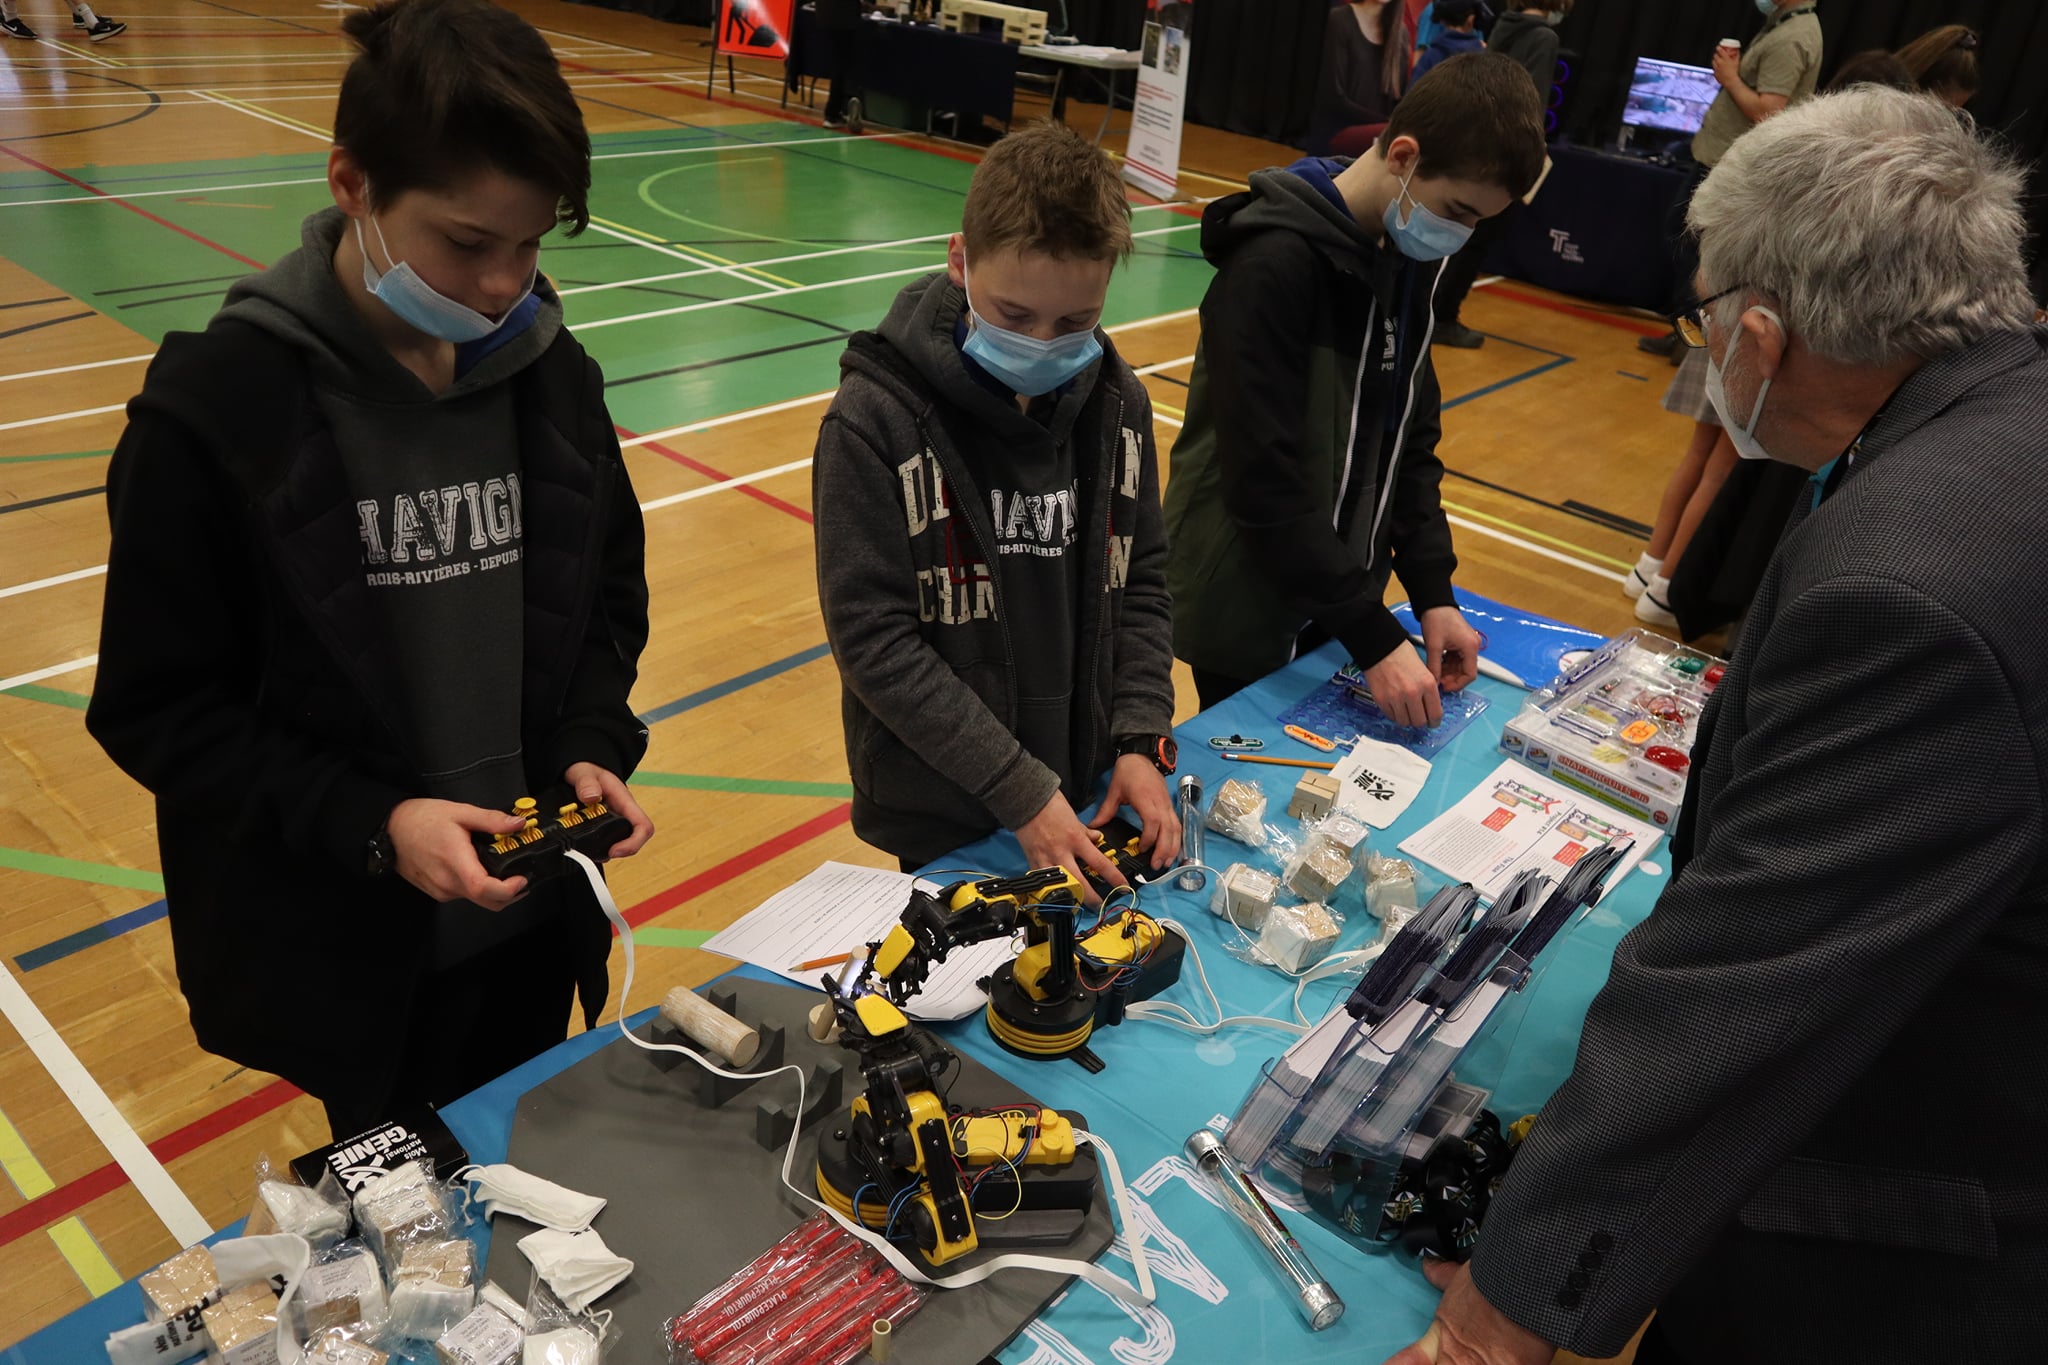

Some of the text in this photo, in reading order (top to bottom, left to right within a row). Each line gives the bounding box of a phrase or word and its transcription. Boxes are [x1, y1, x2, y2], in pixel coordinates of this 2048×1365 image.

[407, 1131, 417, 1141] du
[328, 1125, 408, 1173] GÉNIE
[384, 1137, 422, 1160] national
[402, 1144, 427, 1161] Mois
